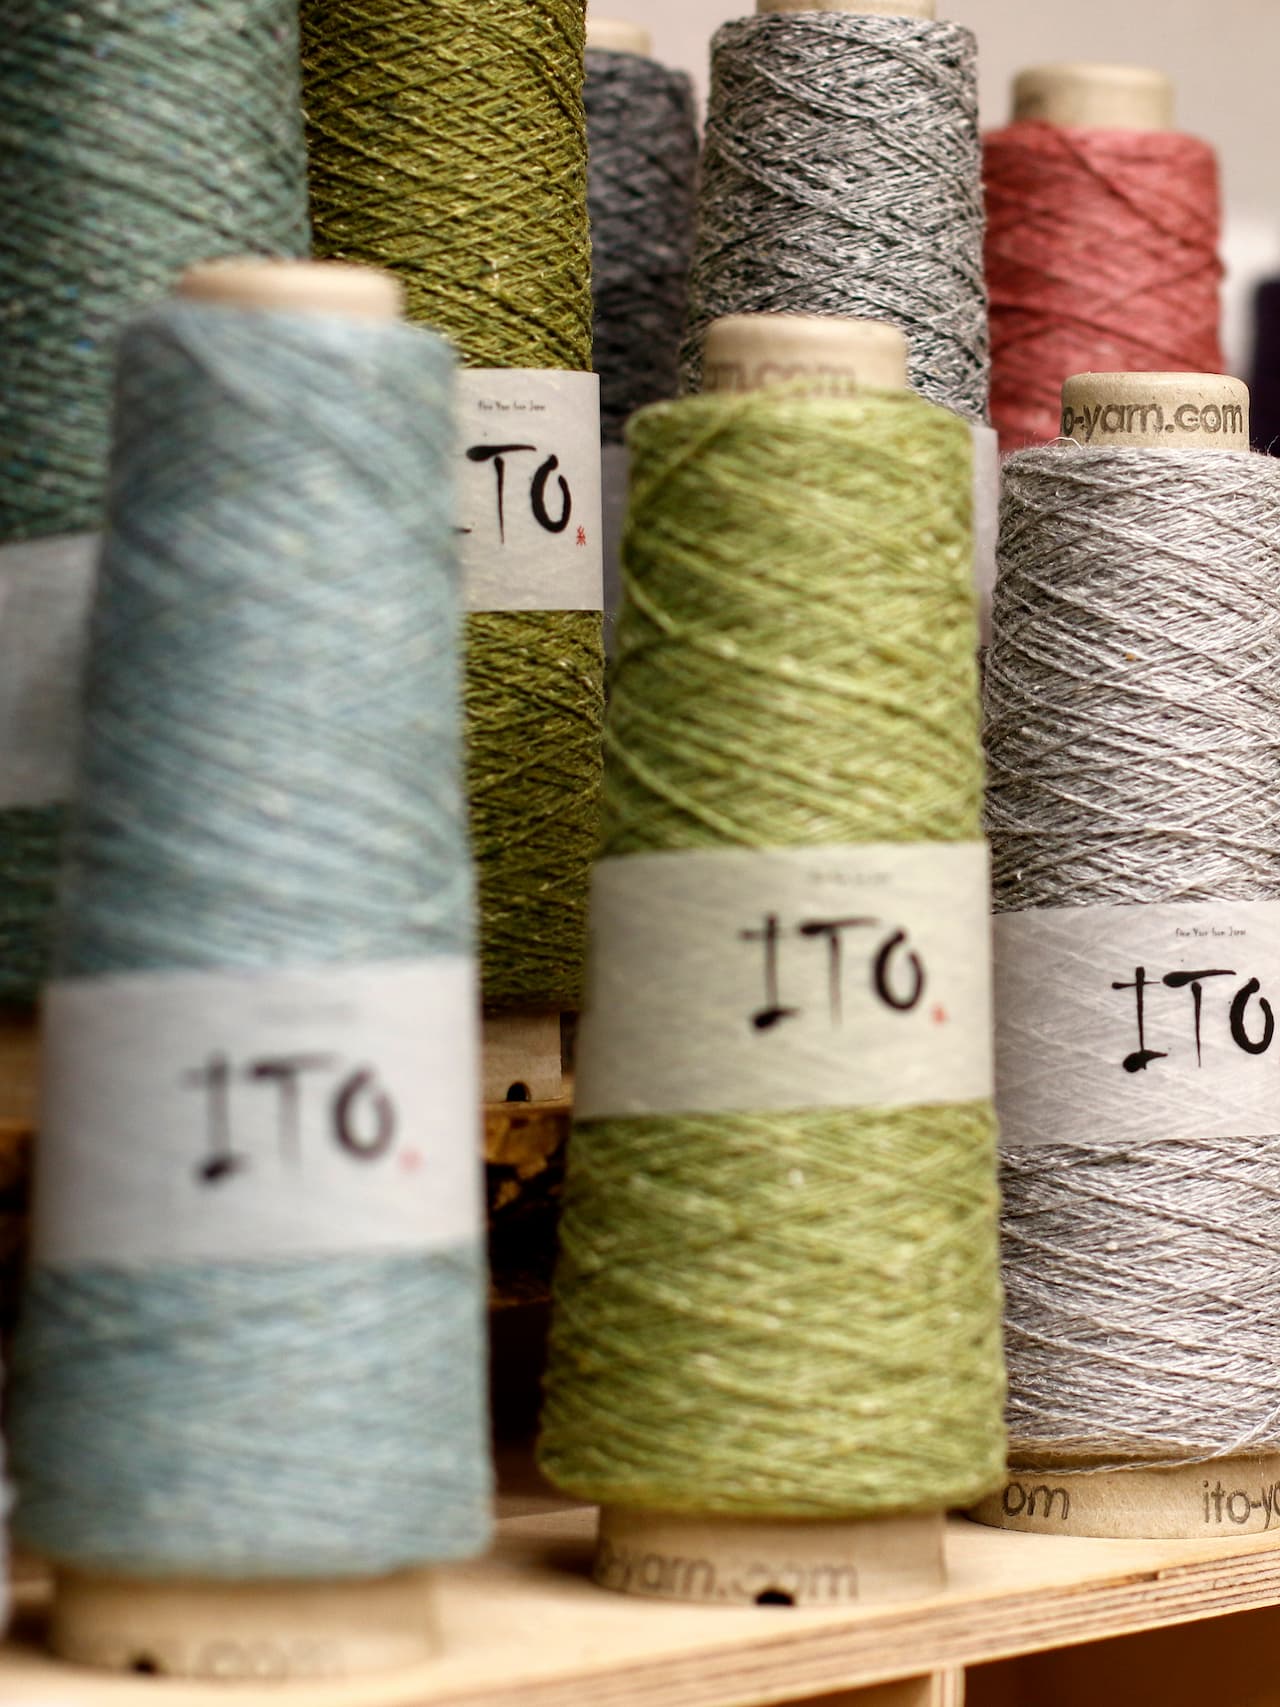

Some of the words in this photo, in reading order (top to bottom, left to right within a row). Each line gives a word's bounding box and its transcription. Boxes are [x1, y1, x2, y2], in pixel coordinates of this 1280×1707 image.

[1062, 402, 1243, 443] o-yarn.com
[455, 444, 571, 544] TO
[739, 913, 925, 1032] ITO
[1111, 966, 1275, 1074] ITO
[179, 1050, 396, 1188] ITO
